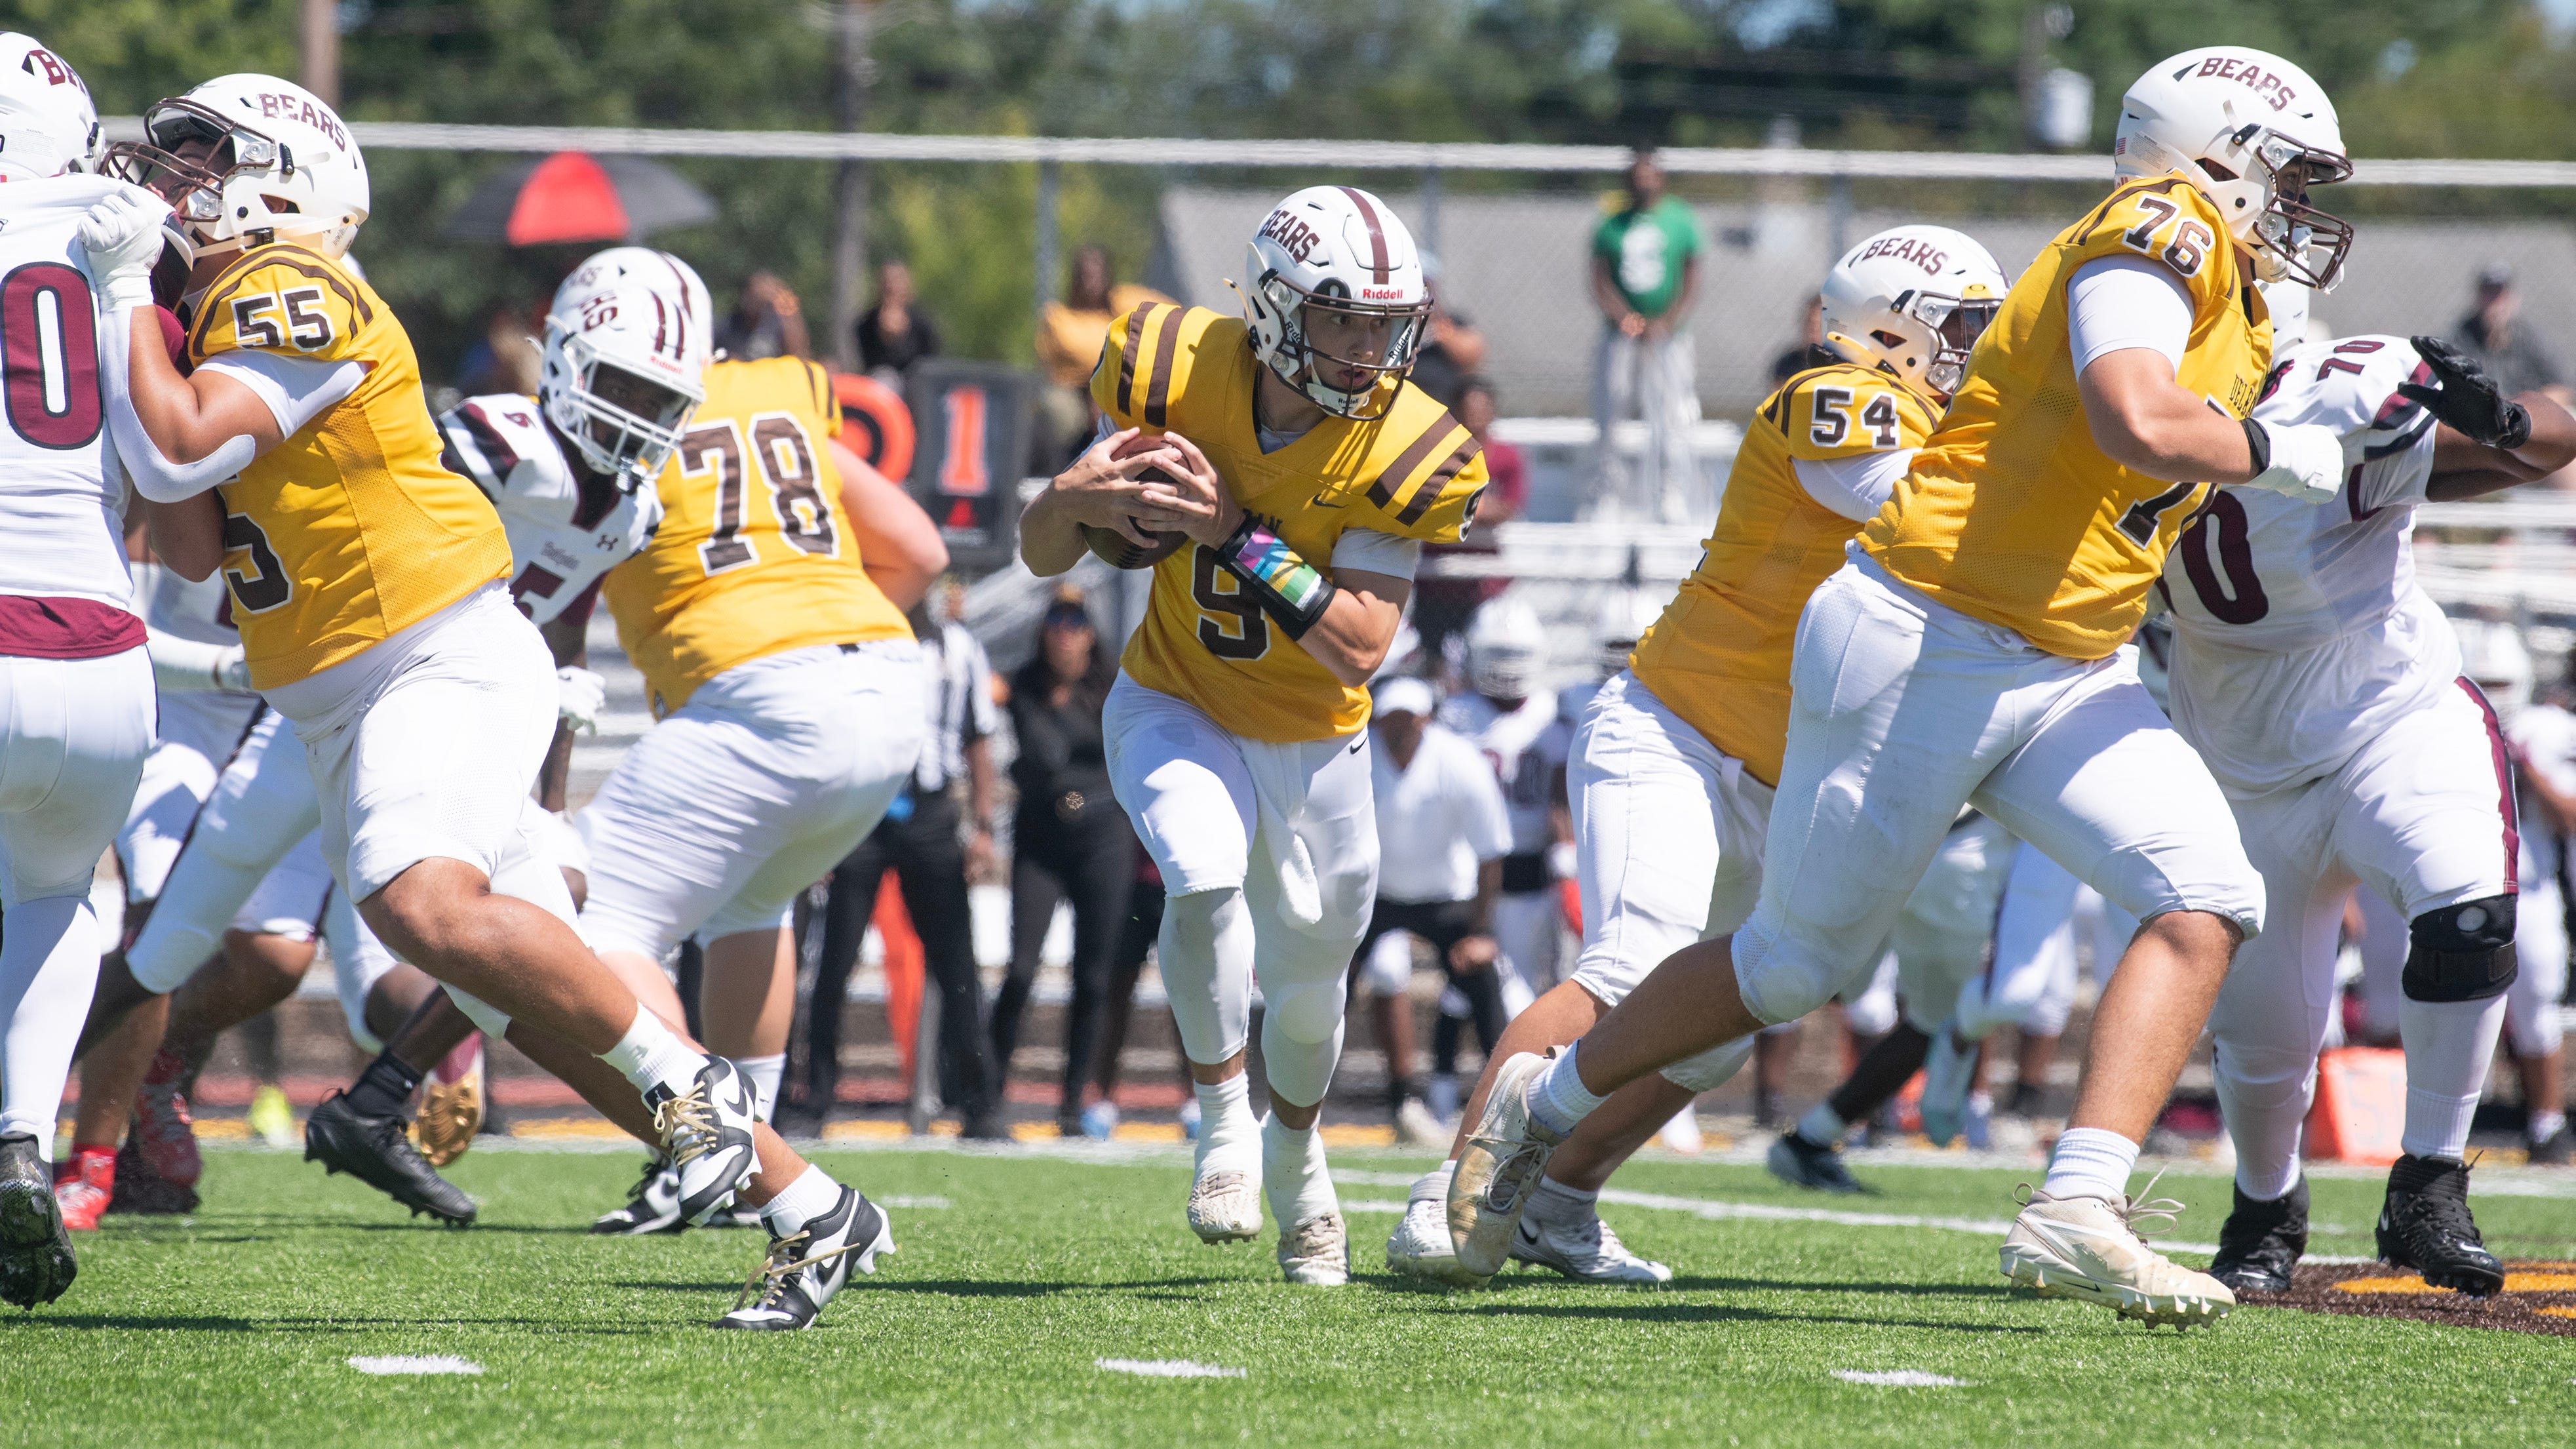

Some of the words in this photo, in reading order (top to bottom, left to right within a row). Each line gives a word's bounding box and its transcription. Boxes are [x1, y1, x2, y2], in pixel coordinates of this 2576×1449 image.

[2196, 57, 2297, 111] BEARS
[258, 93, 346, 152] BEARS
[1257, 209, 1321, 264] BEARS
[1860, 237, 1949, 276] BEARS
[2121, 193, 2217, 279] 76
[229, 285, 336, 353] 55
[1363, 288, 1403, 300] Riddell
[0, 261, 104, 450] 0
[1388, 327, 1413, 359] Riddell
[2316, 340, 2385, 382] 70
[937, 384, 989, 496] 1
[1809, 384, 1901, 449] 54
[675, 410, 840, 578] 78
[2155, 490, 2269, 624] 0
[1190, 542, 1271, 662] 9
